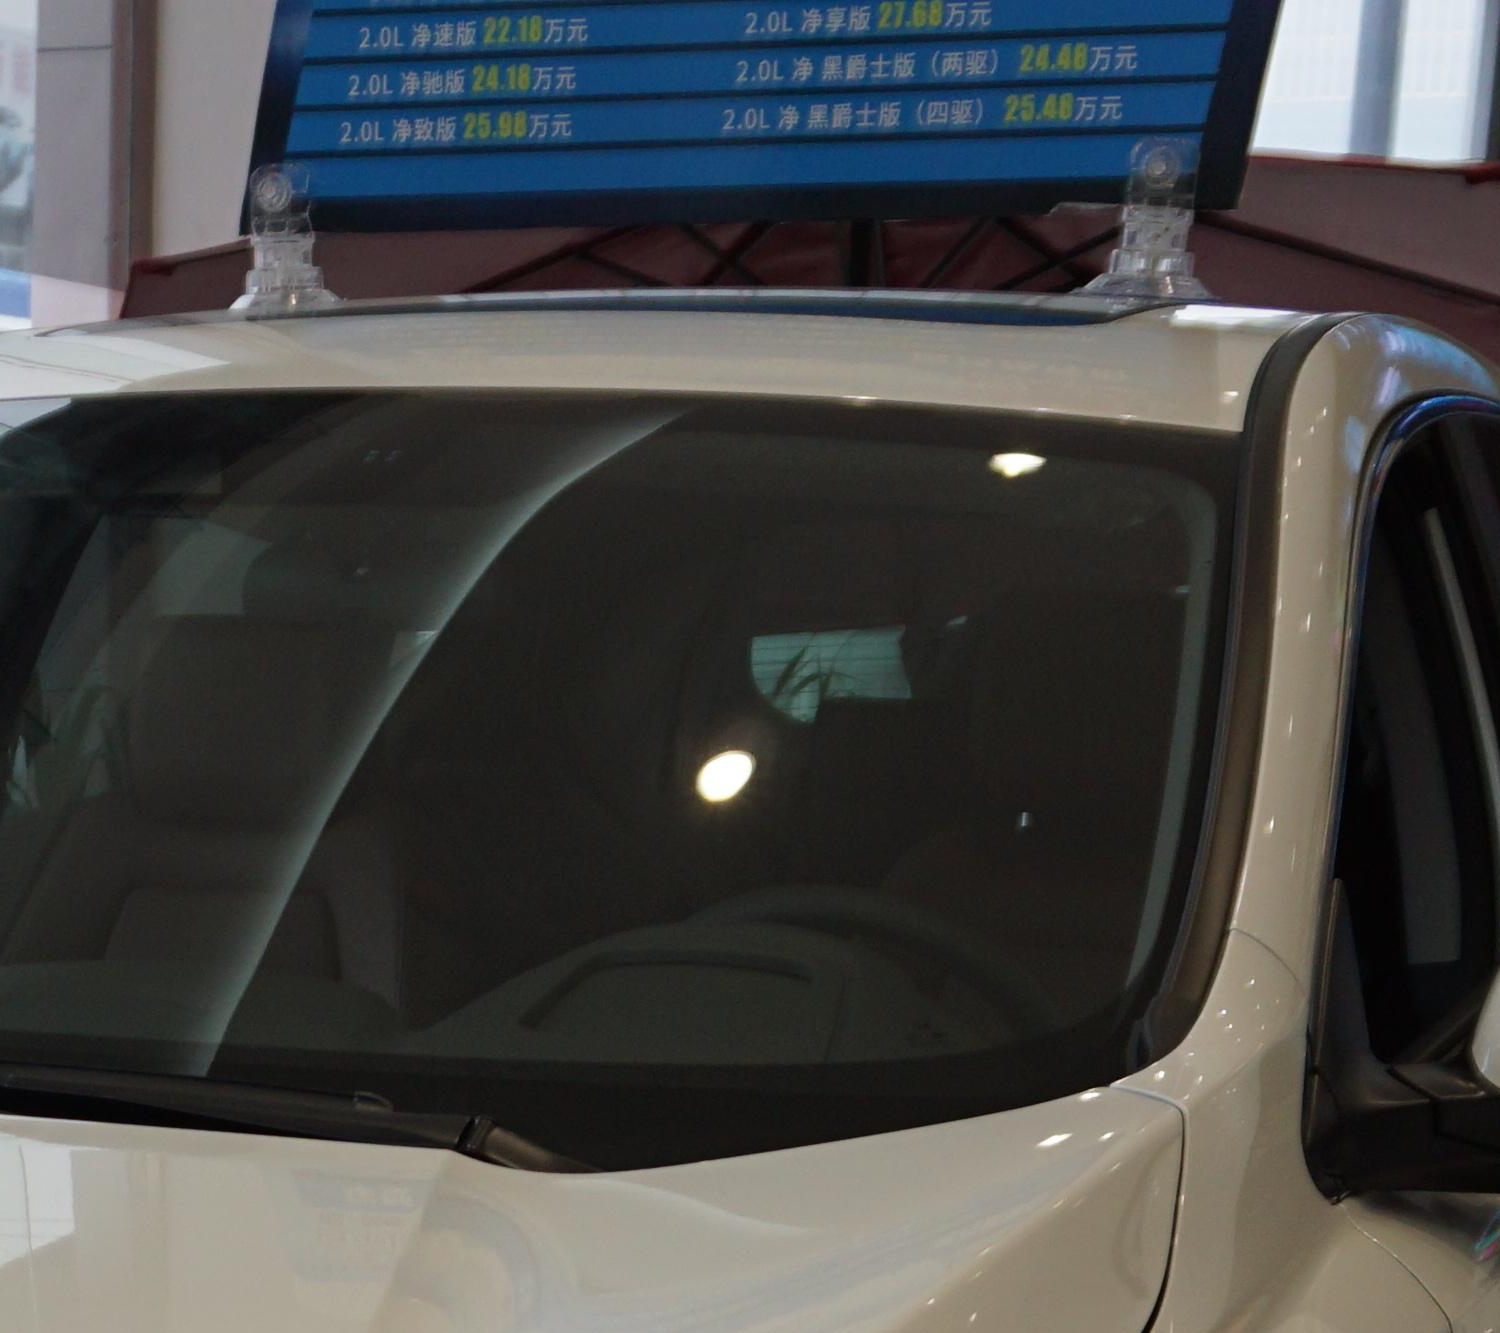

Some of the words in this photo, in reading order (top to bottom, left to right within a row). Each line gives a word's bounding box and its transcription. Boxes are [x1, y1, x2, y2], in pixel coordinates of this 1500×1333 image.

[745, 12, 793, 34] 2.0L
[802, 6, 870, 32] 净享版
[359, 27, 403, 48] 2.0L
[411, 21, 477, 47] 净速版
[348, 74, 393, 96] 2.0L
[400, 69, 466, 95] 净驰版
[736, 60, 783, 82] 2.0L
[793, 58, 813, 81] 净
[339, 122, 384, 143] 2.0L
[392, 117, 456, 143] 净致版
[722, 108, 769, 130] 2.0L
[778, 106, 799, 130] 净
